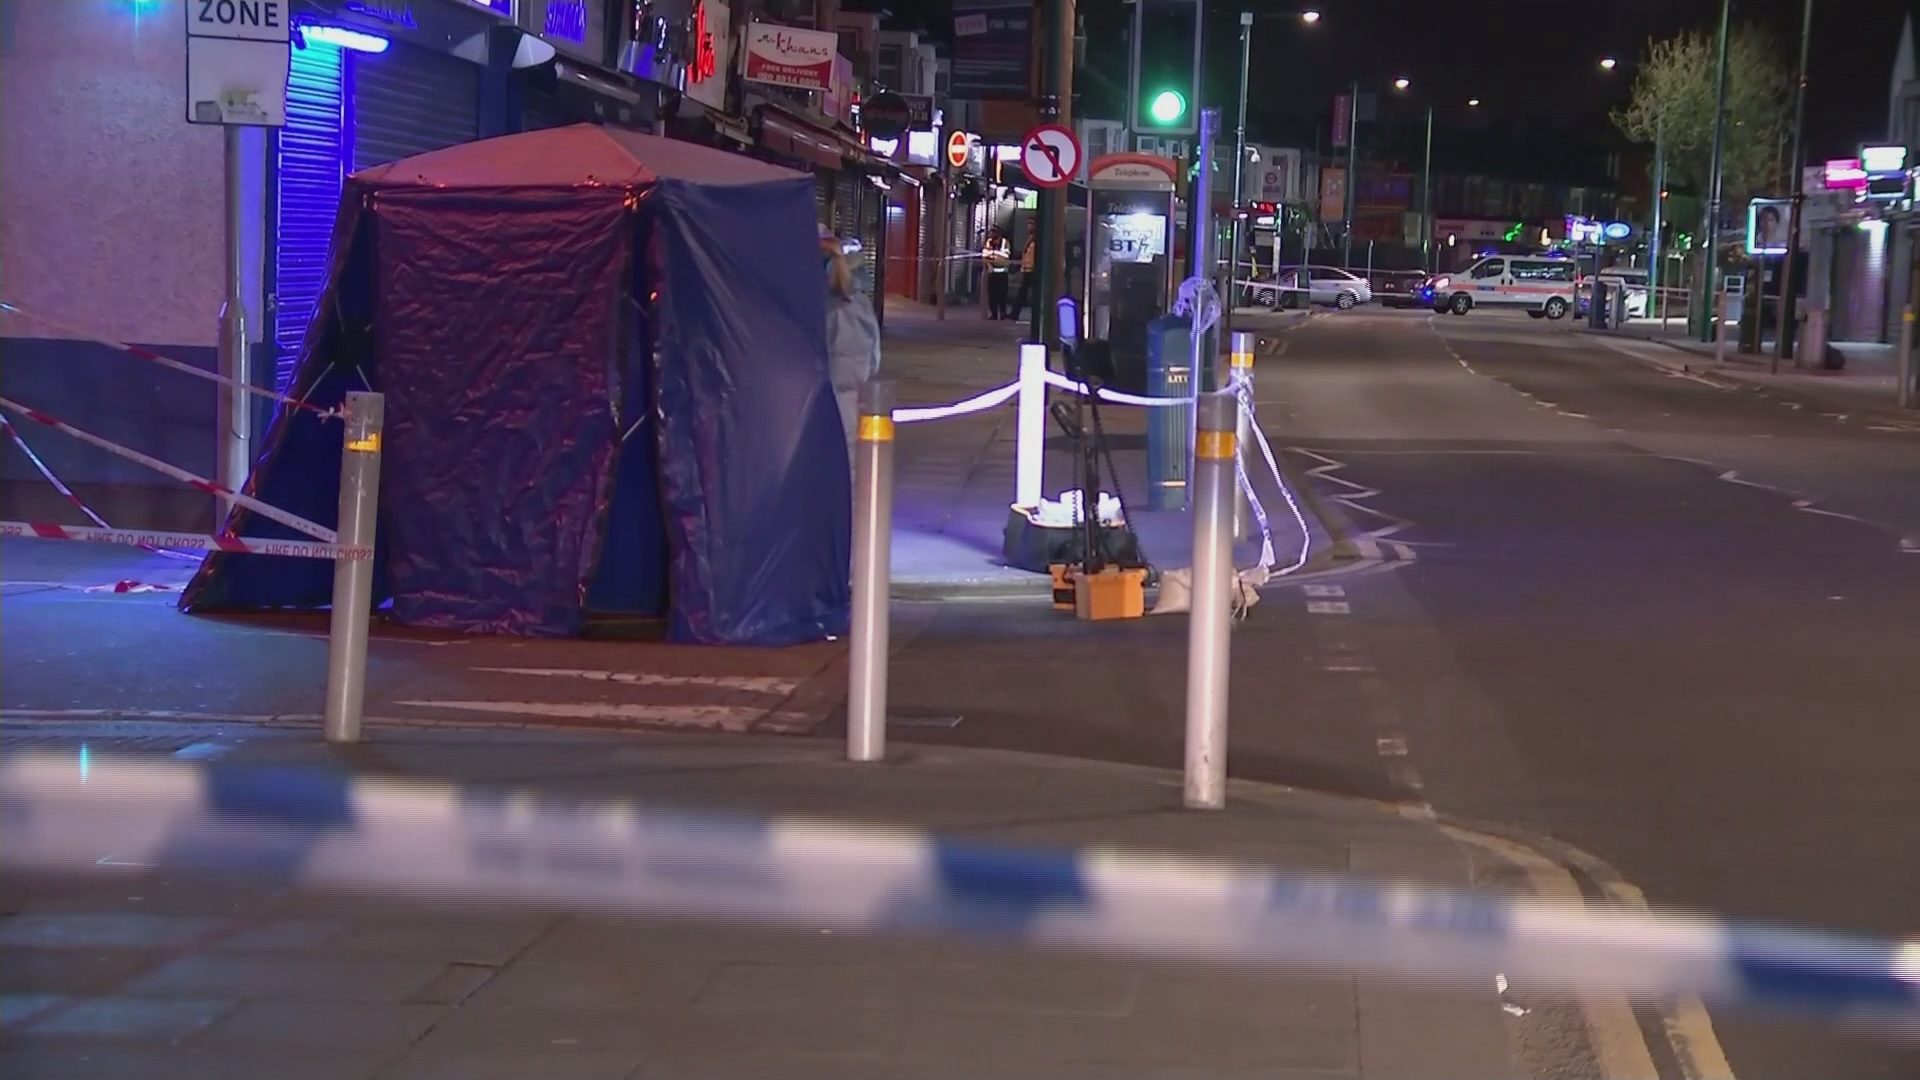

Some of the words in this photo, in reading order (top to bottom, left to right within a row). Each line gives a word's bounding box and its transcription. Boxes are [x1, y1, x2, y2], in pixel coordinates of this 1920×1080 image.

[199, 0, 279, 27] ZONE
[761, 63, 781, 72] FREE
[782, 66, 819, 77] DELIVERY
[1109, 238, 1137, 252] BT
